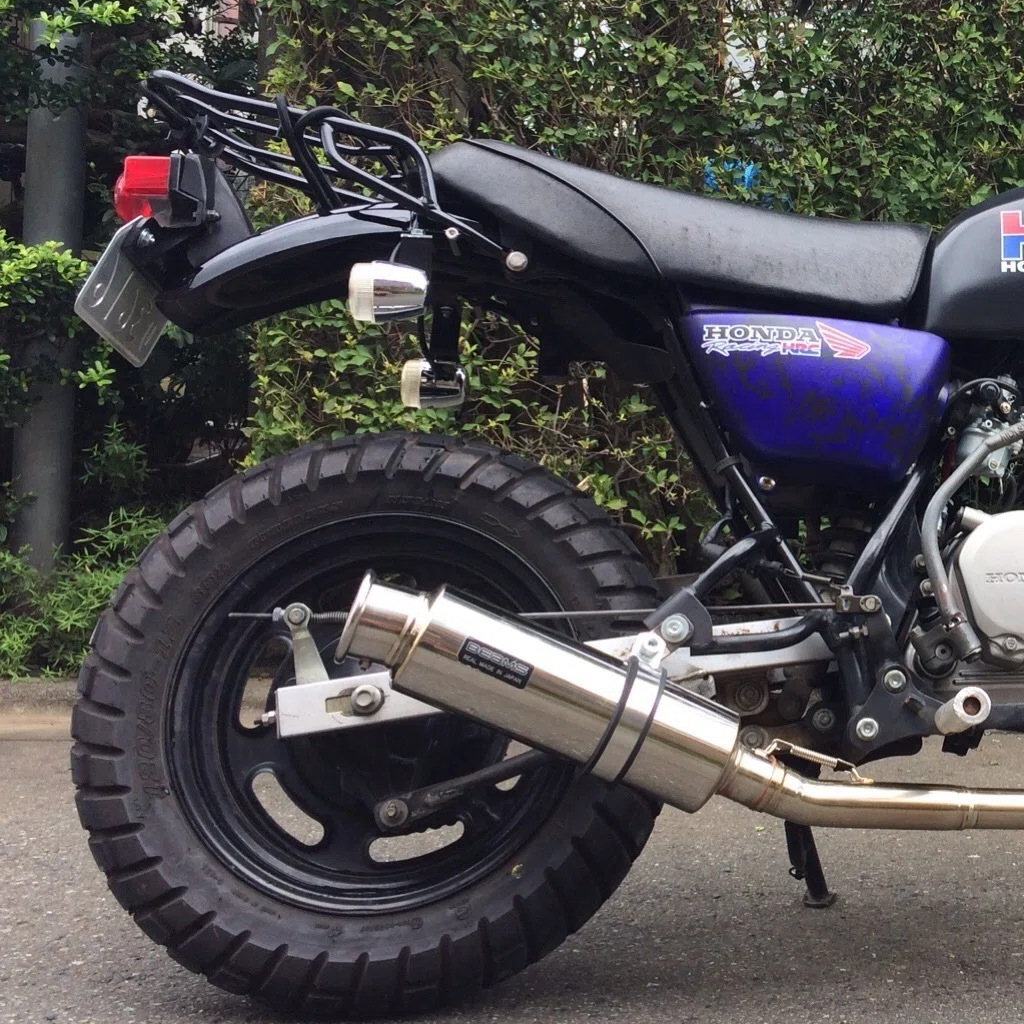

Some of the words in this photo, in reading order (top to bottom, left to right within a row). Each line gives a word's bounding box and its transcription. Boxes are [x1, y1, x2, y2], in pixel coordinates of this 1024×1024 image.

[703, 324, 822, 344] HONDA
[779, 340, 822, 357] HRC
[479, 661, 495, 673] MADE
[503, 672, 522, 685] JAPAN
